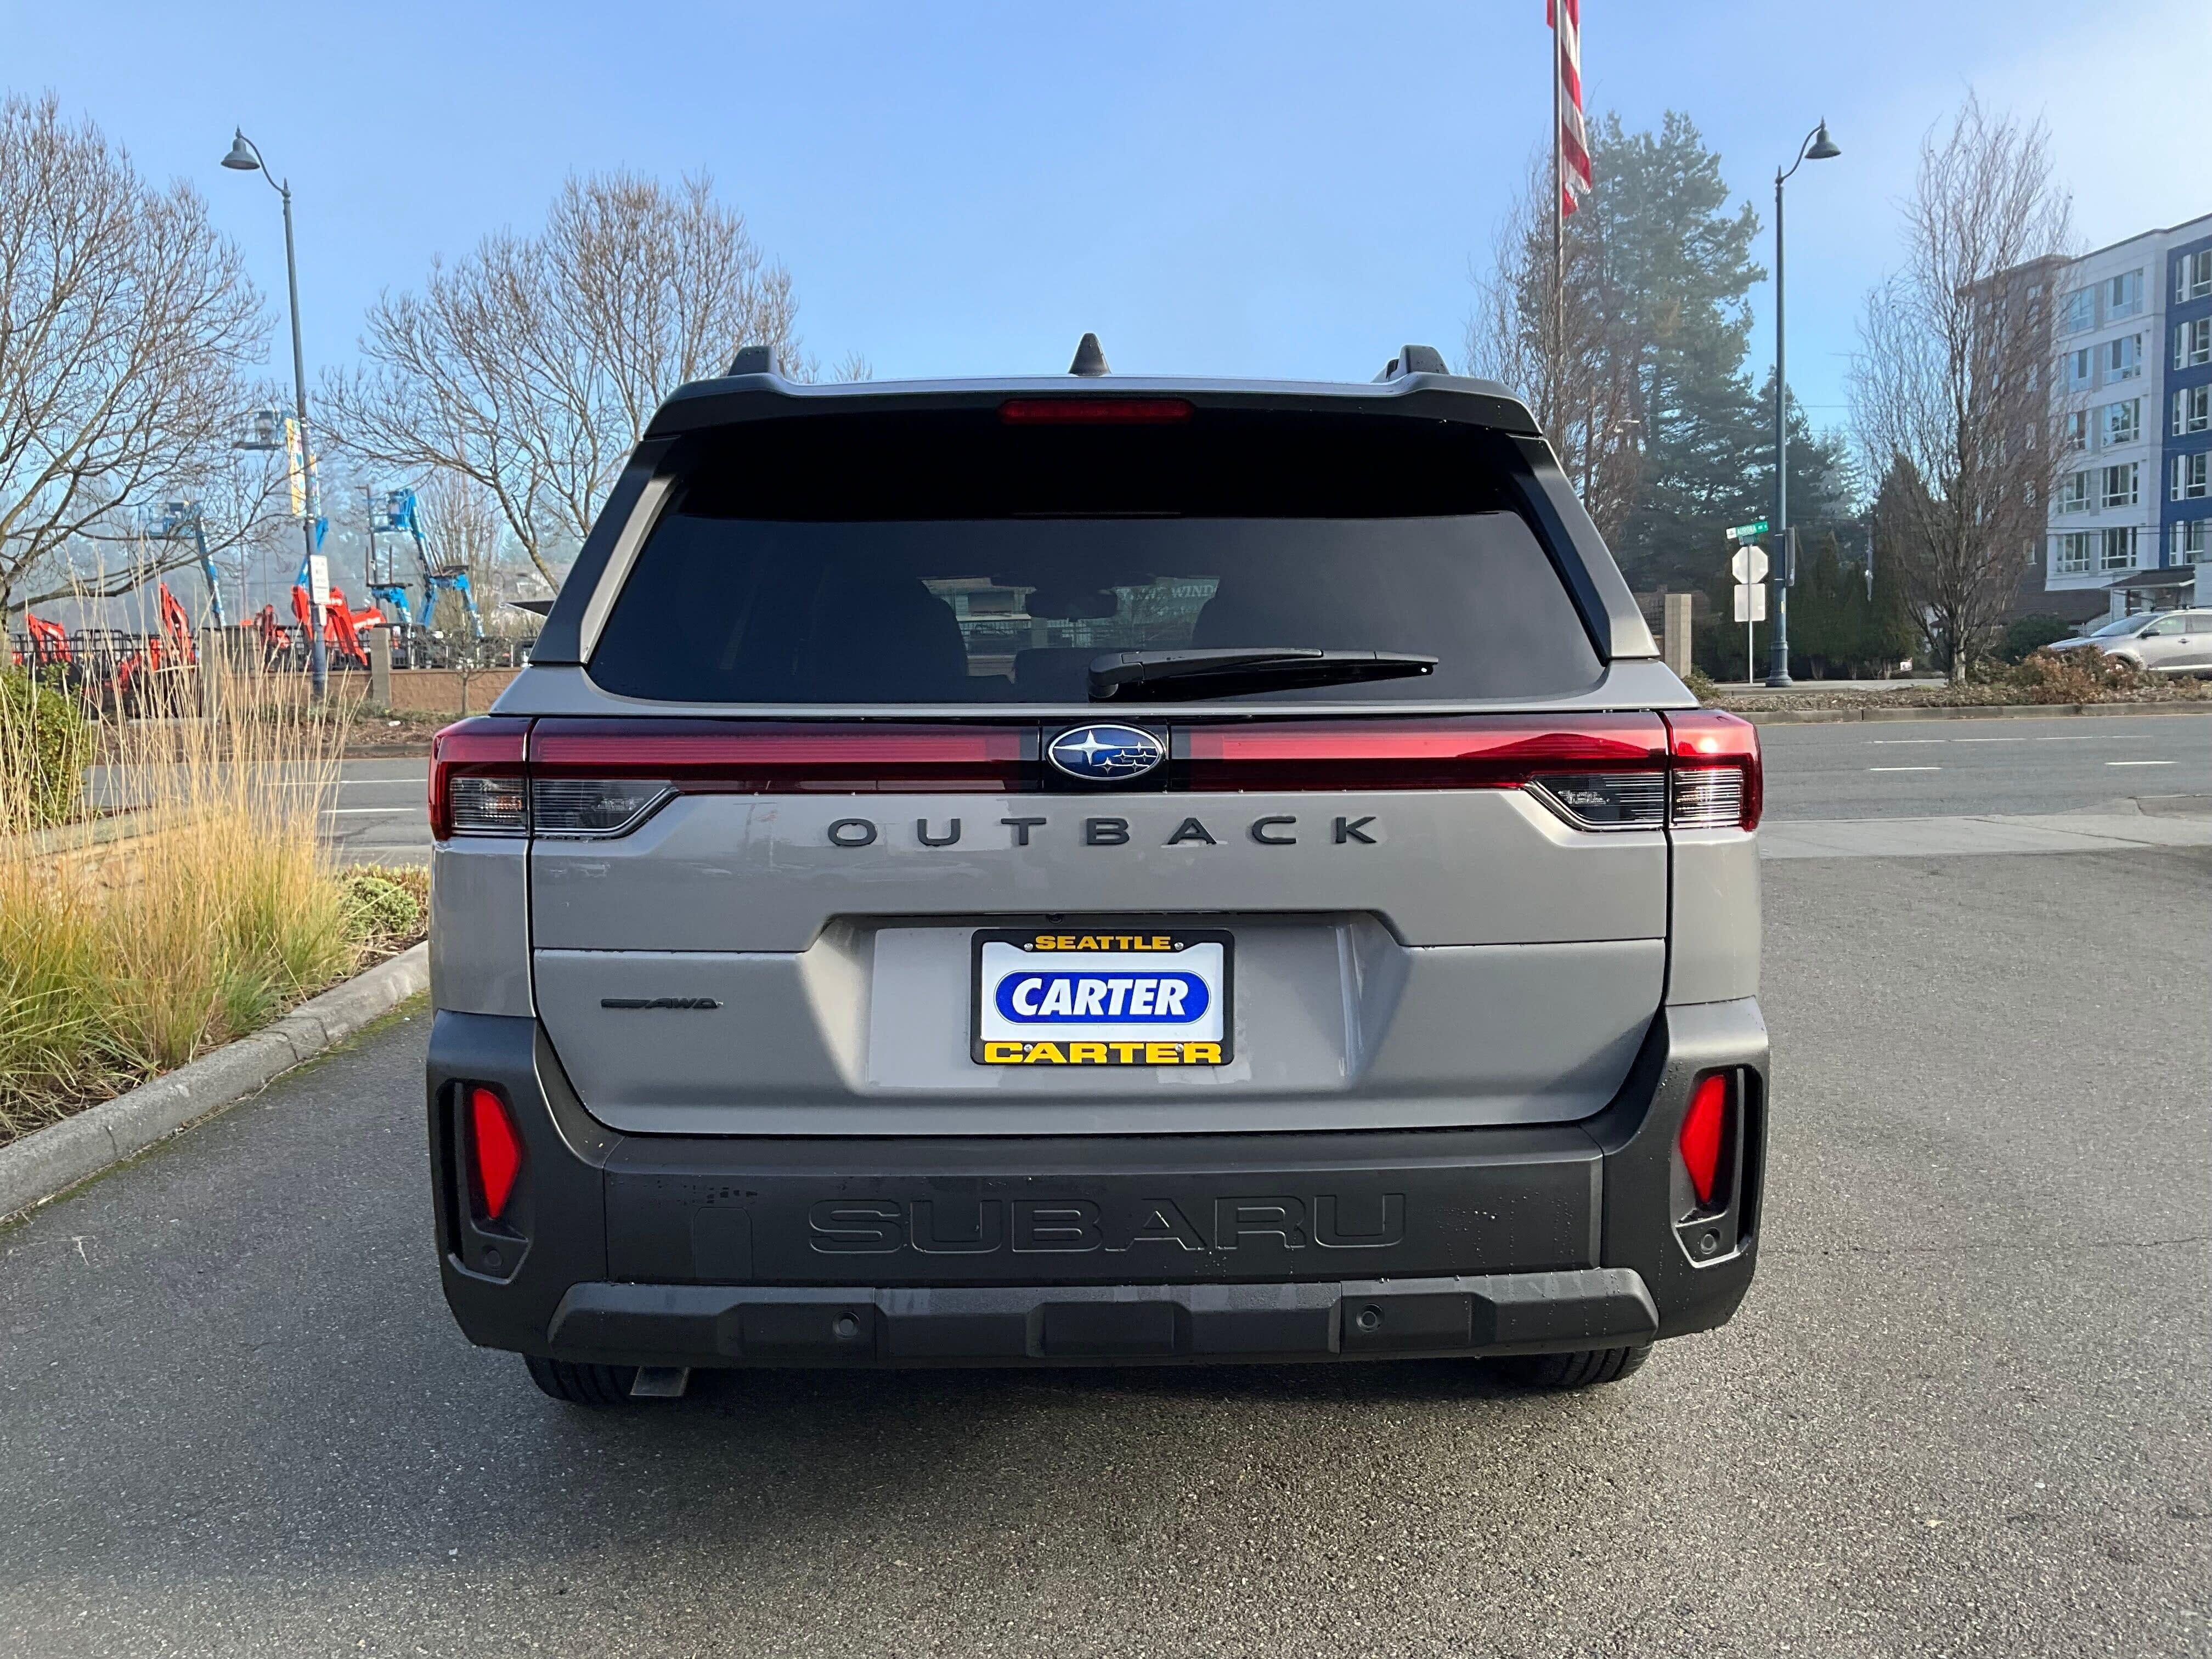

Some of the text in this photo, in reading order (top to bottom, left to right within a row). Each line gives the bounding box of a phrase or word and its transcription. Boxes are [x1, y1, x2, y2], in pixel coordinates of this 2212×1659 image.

[1737, 525, 1757, 535] AURORA
[827, 816, 1378, 847] OUTBACK
[1035, 936, 1171, 950] SEATTLE
[645, 997, 718, 1008] AWD
[1012, 978, 1189, 1016] CARTER
[984, 1043, 1221, 1064] CARTER
[809, 1193, 1406, 1254] SUBARU
